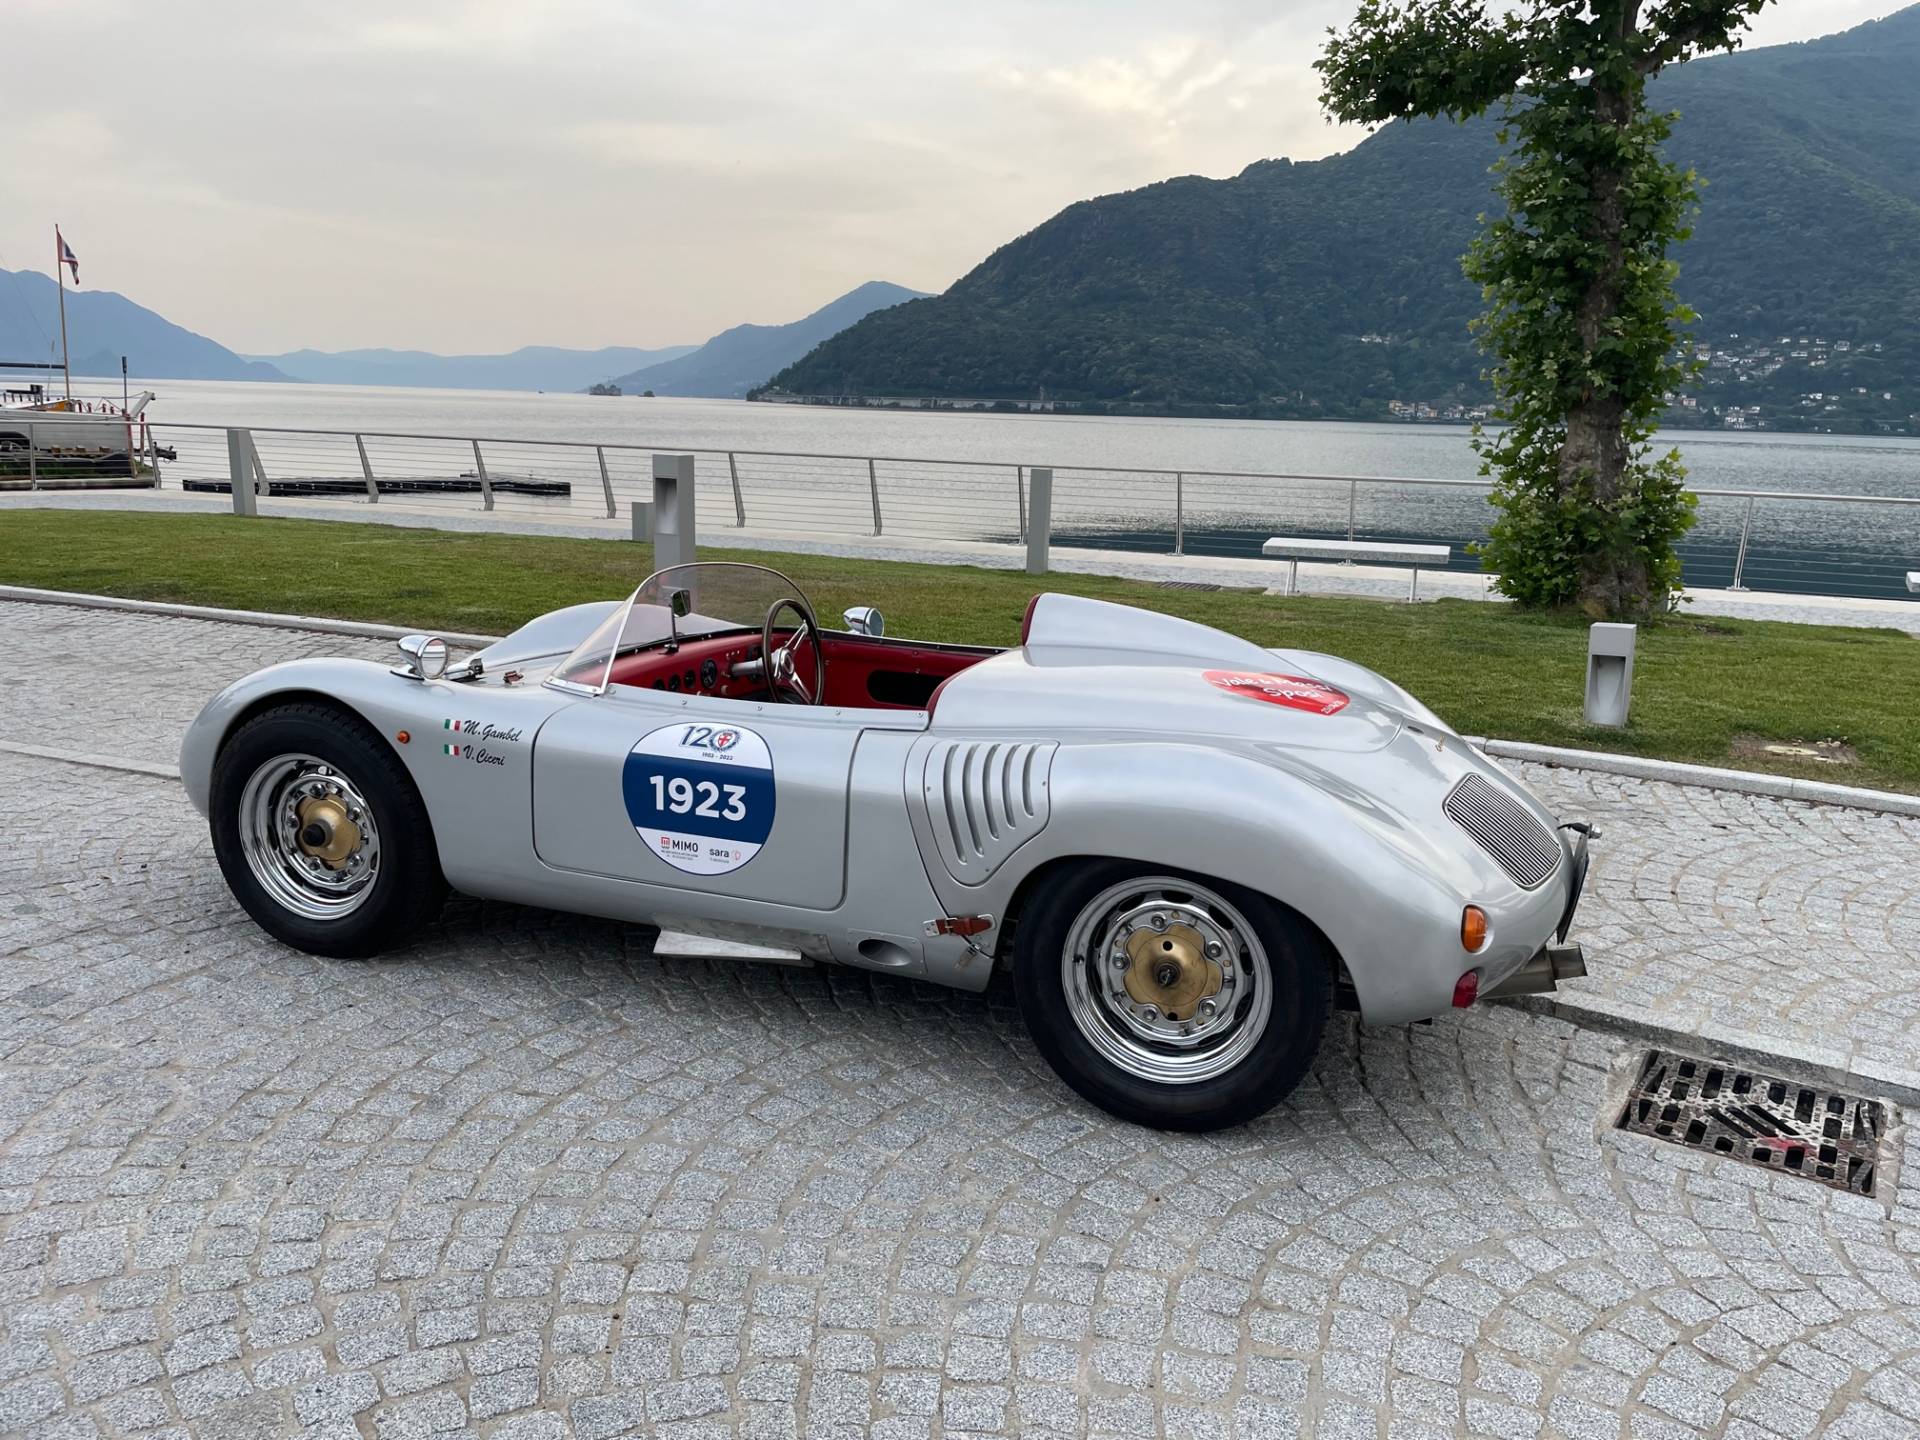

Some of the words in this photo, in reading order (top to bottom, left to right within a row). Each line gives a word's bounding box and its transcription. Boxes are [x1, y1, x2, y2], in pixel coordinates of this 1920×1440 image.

[464, 719, 481, 736] M.
[482, 724, 523, 741] Gambel
[463, 745, 475, 760] V.
[649, 775, 747, 821] 1923
[672, 840, 699, 853] MIMO
[709, 848, 730, 858] sara
